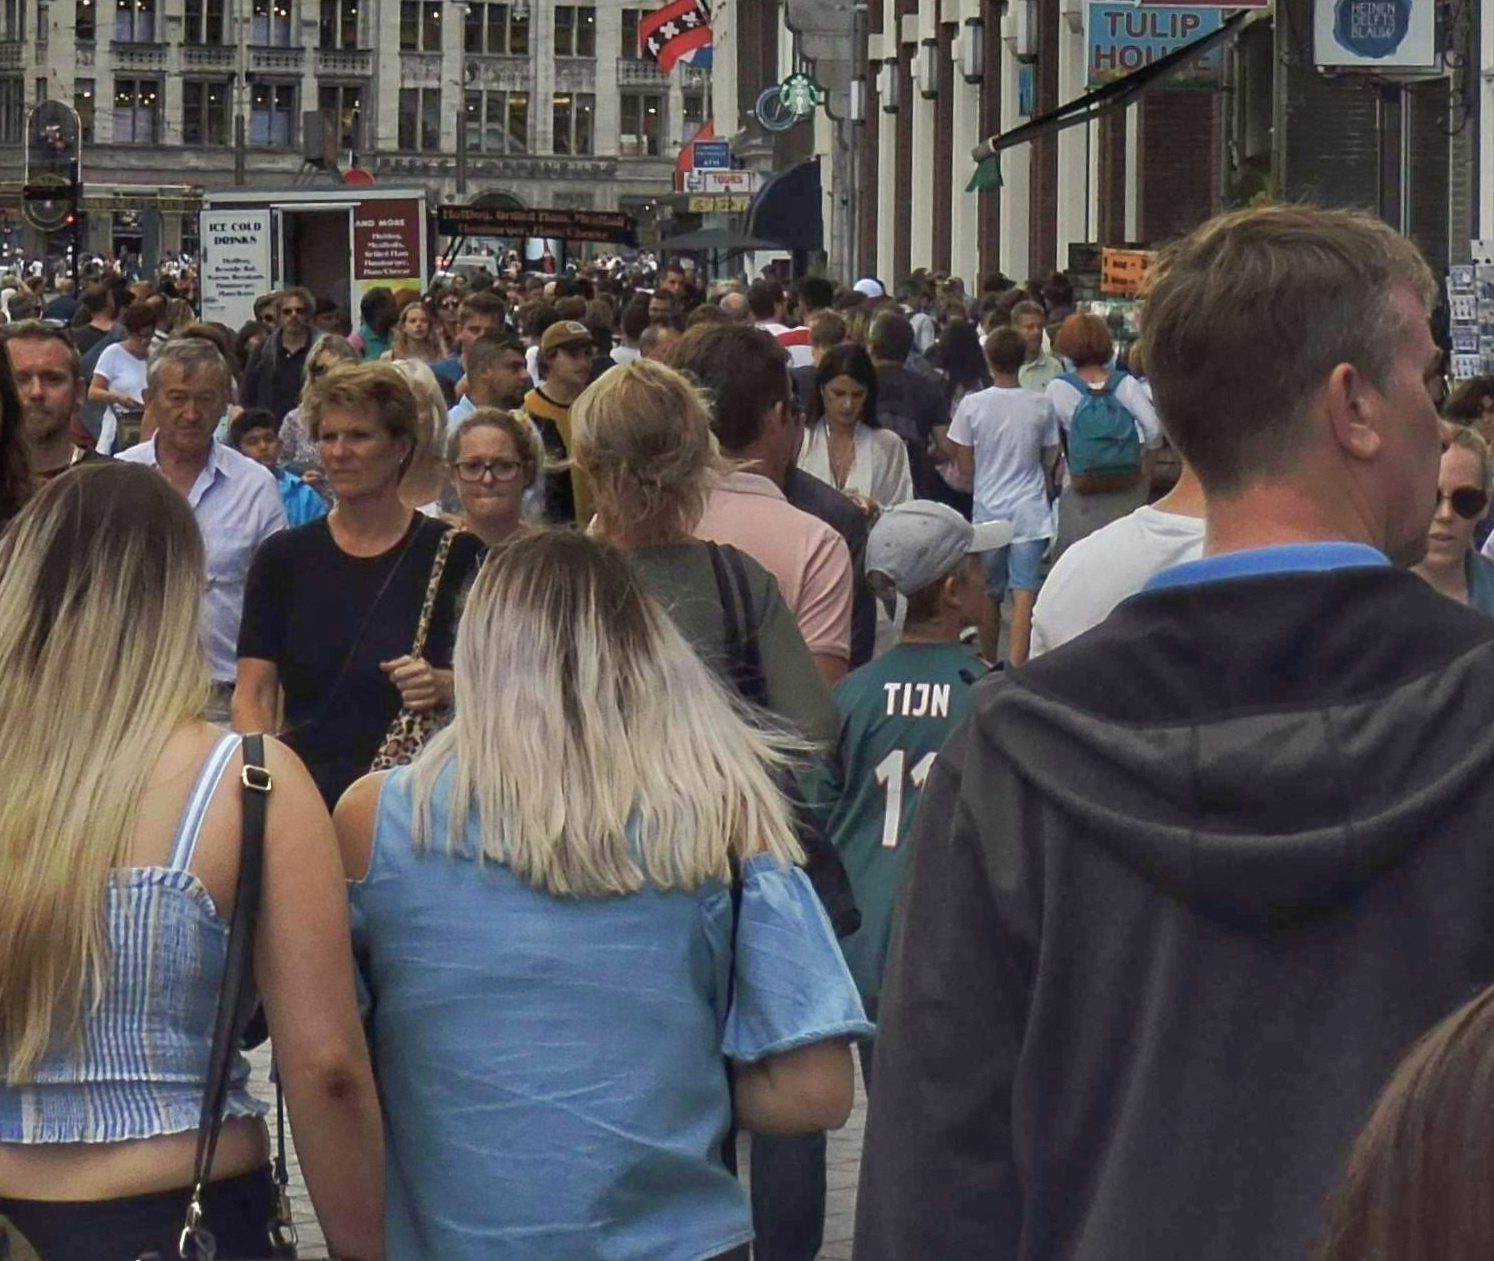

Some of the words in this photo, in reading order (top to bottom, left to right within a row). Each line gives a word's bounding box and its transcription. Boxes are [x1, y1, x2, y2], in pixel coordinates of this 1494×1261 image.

[1351, 1, 1396, 13] HEINEN
[1104, 11, 1201, 39] TULIP
[1351, 27, 1395, 38] BLAUW
[1094, 44, 1212, 71] HOUE
[209, 223, 227, 232] ICE
[231, 222, 262, 231] COLD
[355, 219, 375, 227] AND
[378, 218, 405, 227] MORE
[214, 236, 258, 245] DRINKS
[883, 682, 951, 719] TIJN
